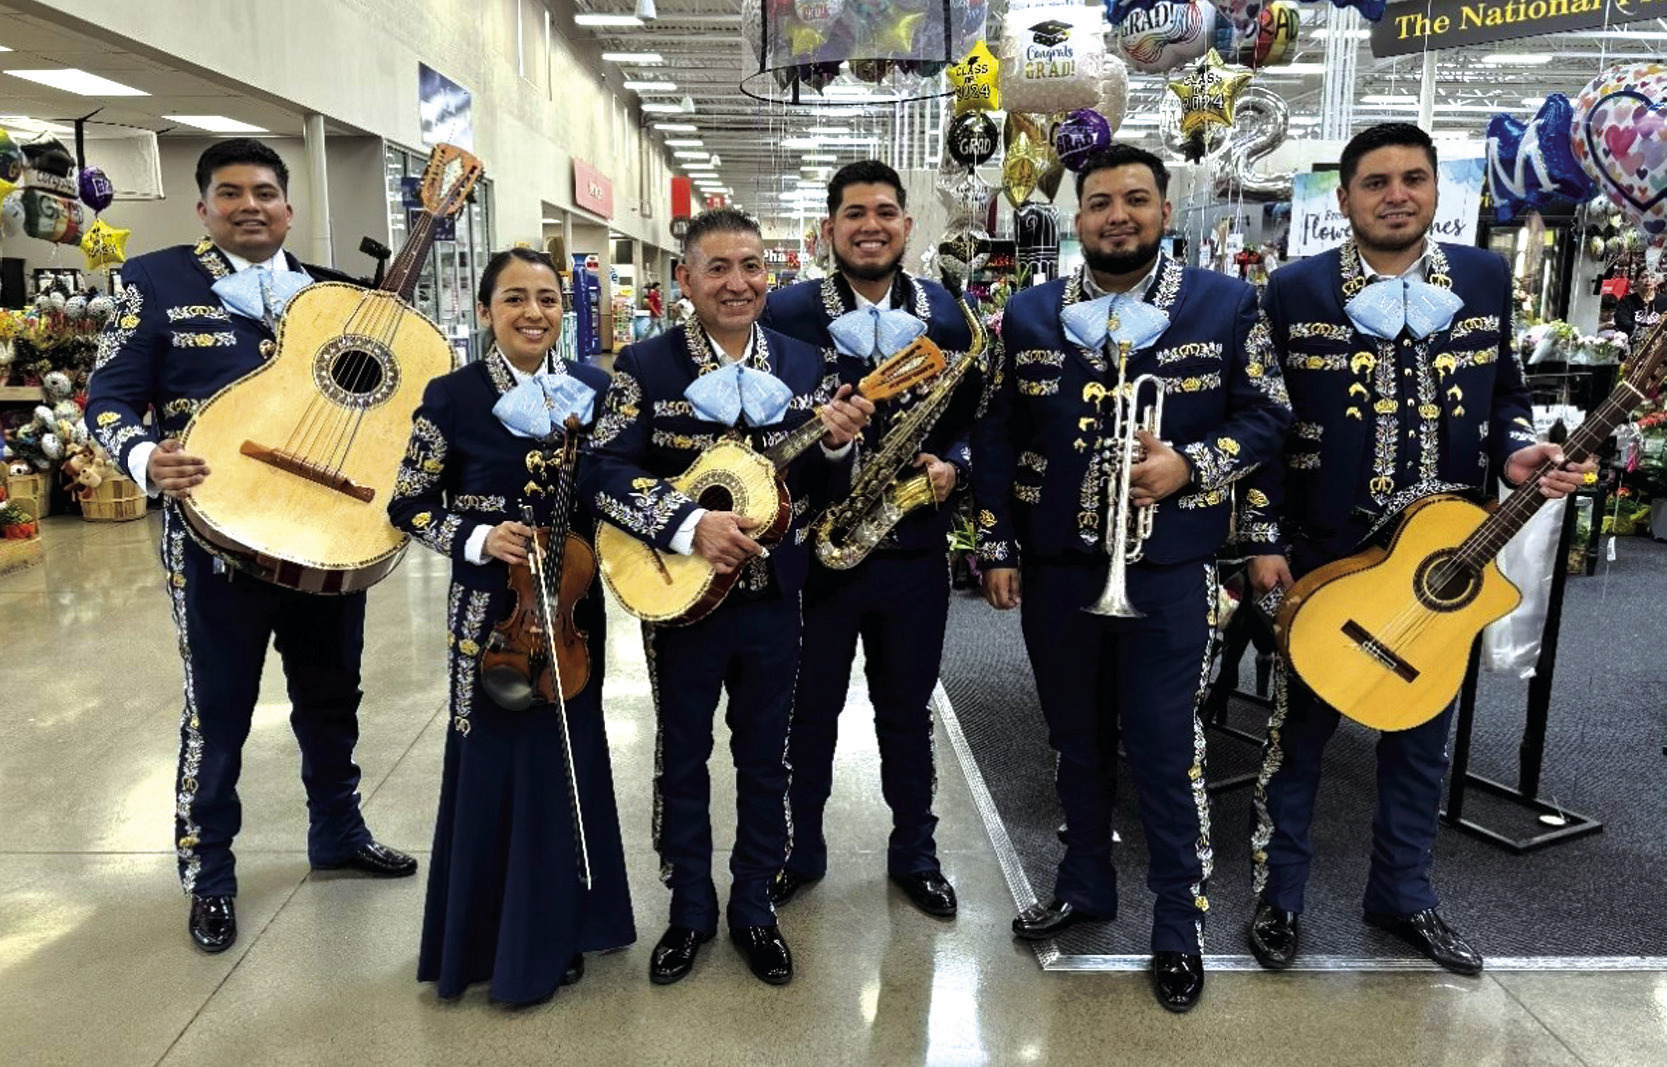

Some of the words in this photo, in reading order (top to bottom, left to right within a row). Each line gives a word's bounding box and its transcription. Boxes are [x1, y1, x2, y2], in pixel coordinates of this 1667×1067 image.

[1395, 13, 1450, 39] The
[956, 64, 989, 76] CLASS
[1025, 60, 1075, 79] GRAD!
[1183, 72, 1223, 86] CLASS
[956, 83, 990, 101] 2024
[1182, 93, 1225, 112] 2024
[959, 137, 991, 155] GRAD
[1057, 133, 1093, 156] GRAD
[1428, 218, 1467, 236] nes
